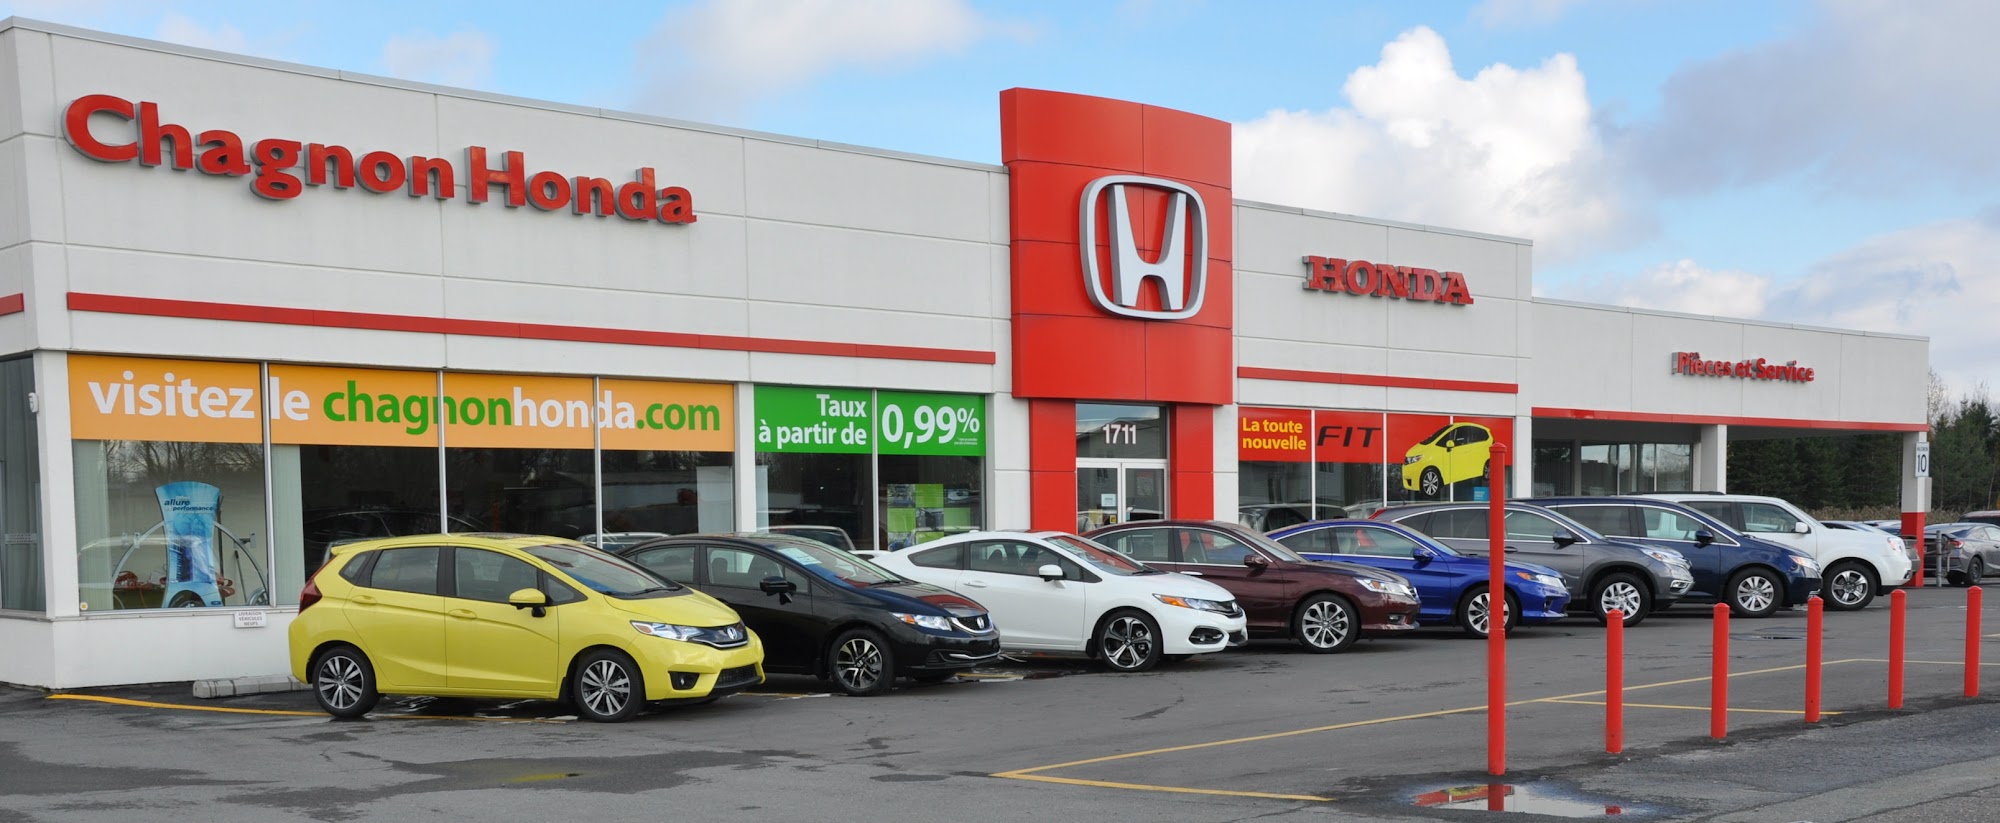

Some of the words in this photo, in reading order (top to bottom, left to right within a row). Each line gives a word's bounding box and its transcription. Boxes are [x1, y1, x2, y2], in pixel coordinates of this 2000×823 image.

[62, 94, 455, 202] Chagnon
[464, 145, 697, 225] Honda
[1303, 255, 1474, 305] HONDA
[1672, 352, 1732, 377] Pièces
[1734, 359, 1753, 378] et
[1752, 358, 1814, 382] Service
[88, 370, 255, 418] visitez
[270, 376, 310, 421] le
[323, 380, 720, 435] chagnonhonda.com
[816, 394, 867, 418] Taux
[758, 419, 771, 443] à
[776, 422, 837, 450] partir
[840, 422, 867, 445] de
[882, 404, 980, 449] 0,99%
[1102, 423, 1136, 445] 1711
[1242, 417, 1260, 432] La
[1263, 419, 1303, 434] toute
[1316, 425, 1382, 448] FIT
[1242, 435, 1307, 450] nouvelle
[1917, 454, 1927, 473] 10
